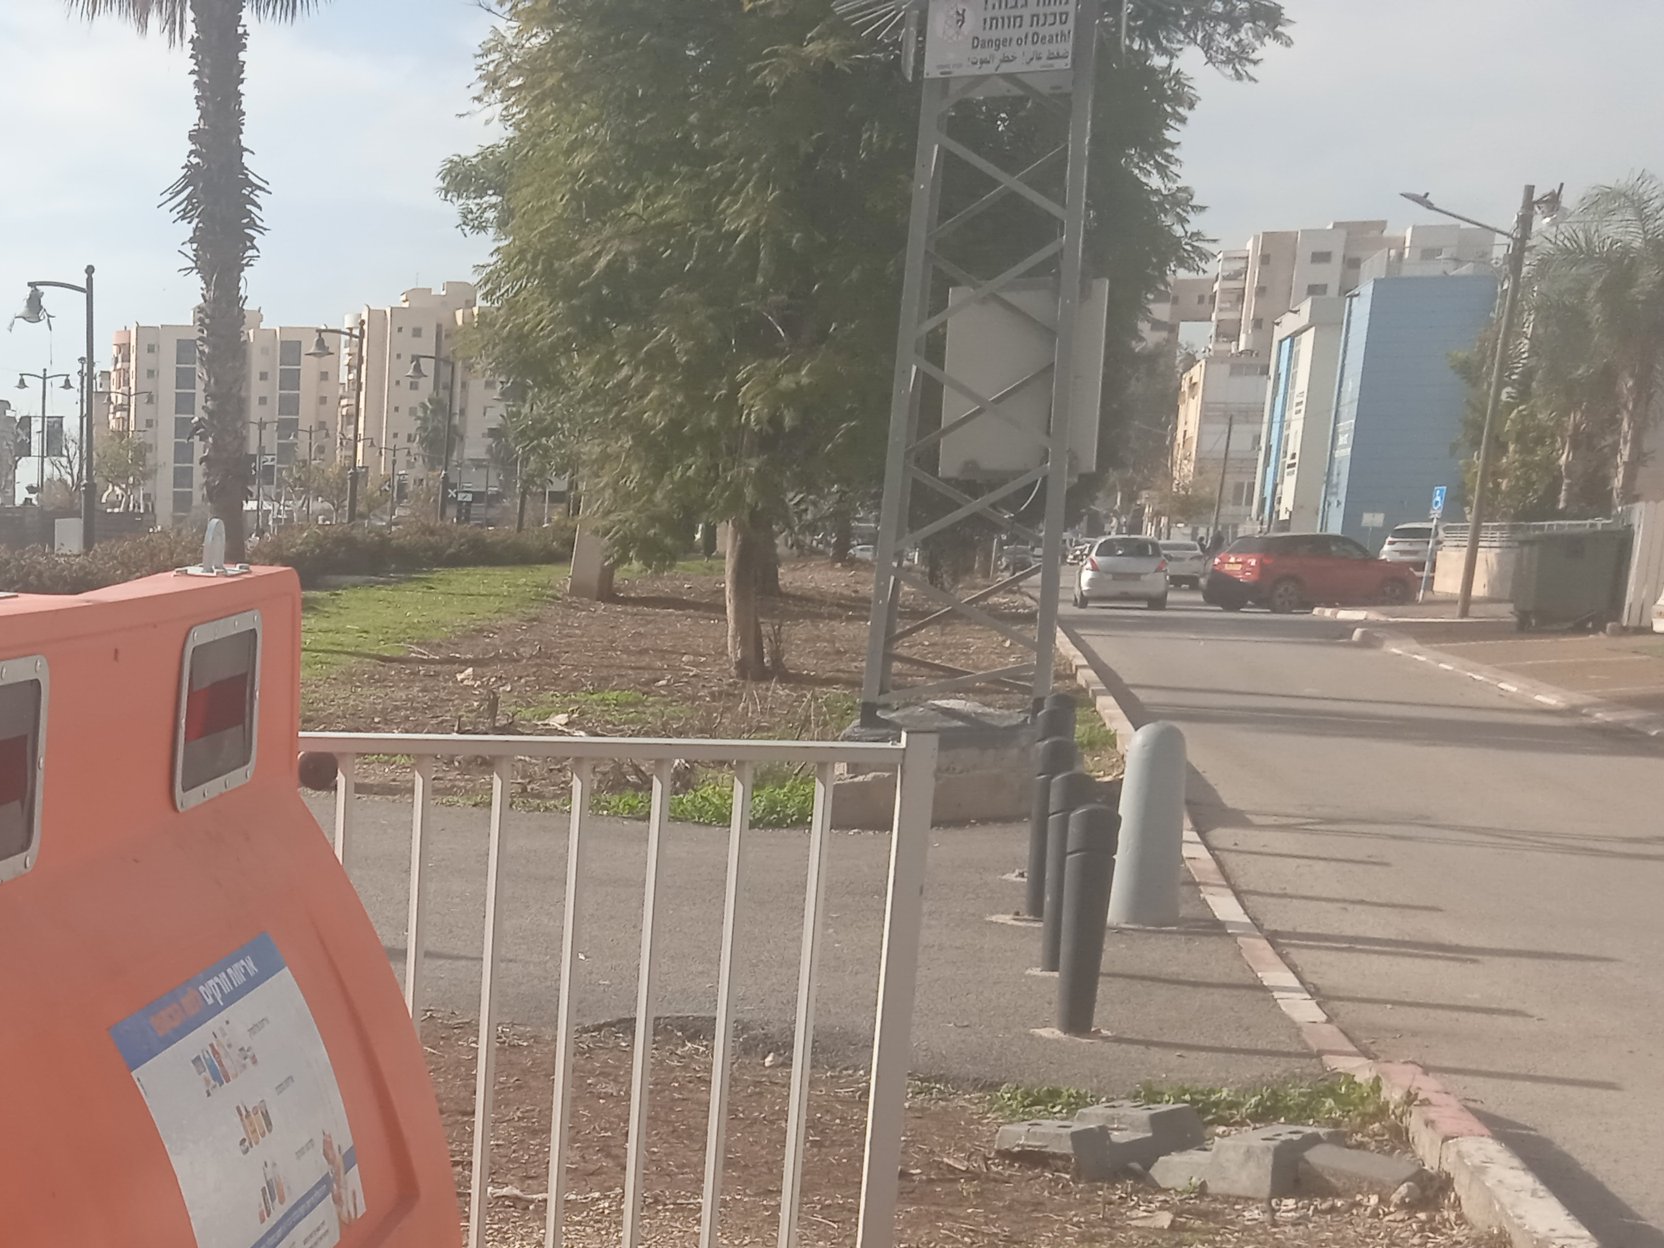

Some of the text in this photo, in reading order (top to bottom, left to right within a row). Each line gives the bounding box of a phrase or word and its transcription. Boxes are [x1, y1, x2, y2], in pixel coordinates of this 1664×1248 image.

[982, 11, 1070, 31] סכנת מוות!
[971, 29, 1071, 51] Danger of Death!
[226, 955, 259, 988] אריזות
[198, 971, 234, 1006] זורקים
